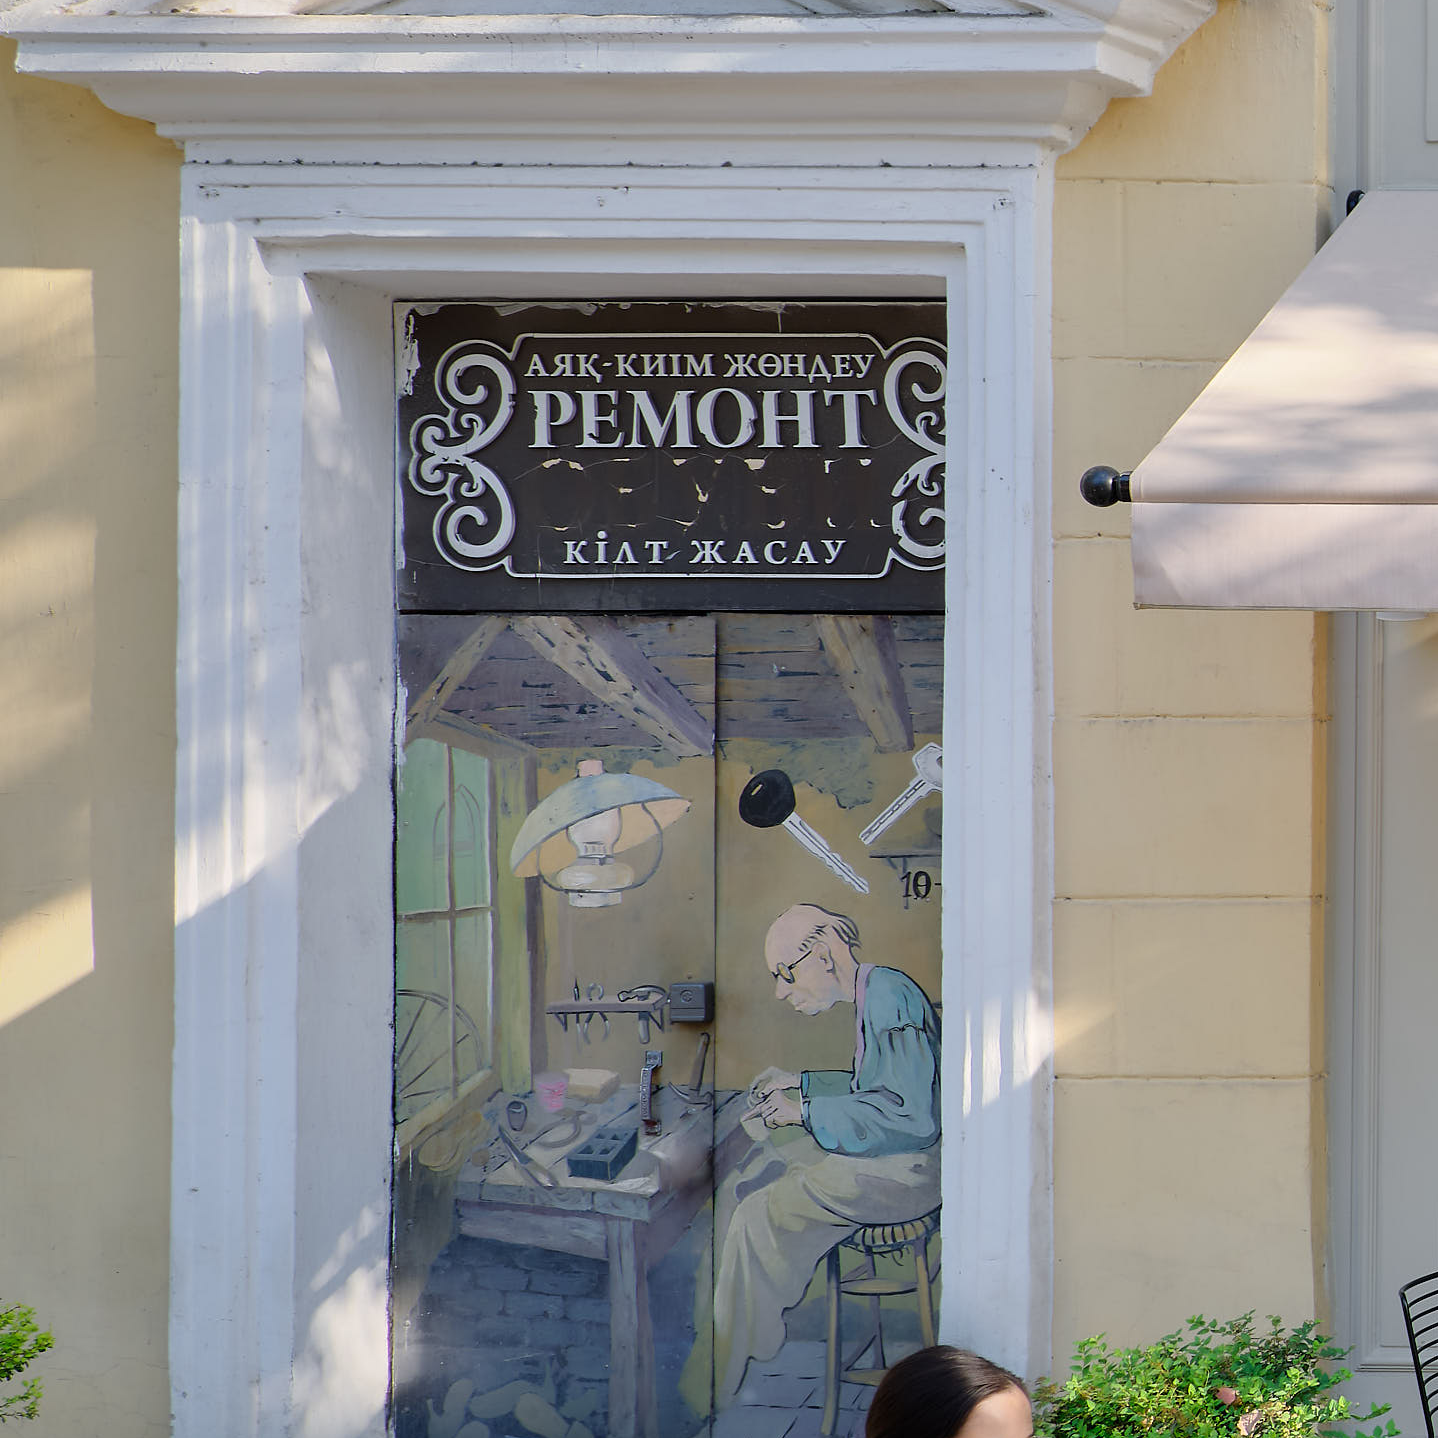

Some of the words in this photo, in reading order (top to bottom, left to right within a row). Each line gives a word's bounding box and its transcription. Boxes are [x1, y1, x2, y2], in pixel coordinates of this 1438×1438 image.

[524, 352, 715, 384] АЯҚ-КИІМ
[723, 352, 877, 384] ЖӨНДЕУ
[526, 387, 879, 450] РЕМОНТ
[689, 538, 848, 565] ЖАСАУ
